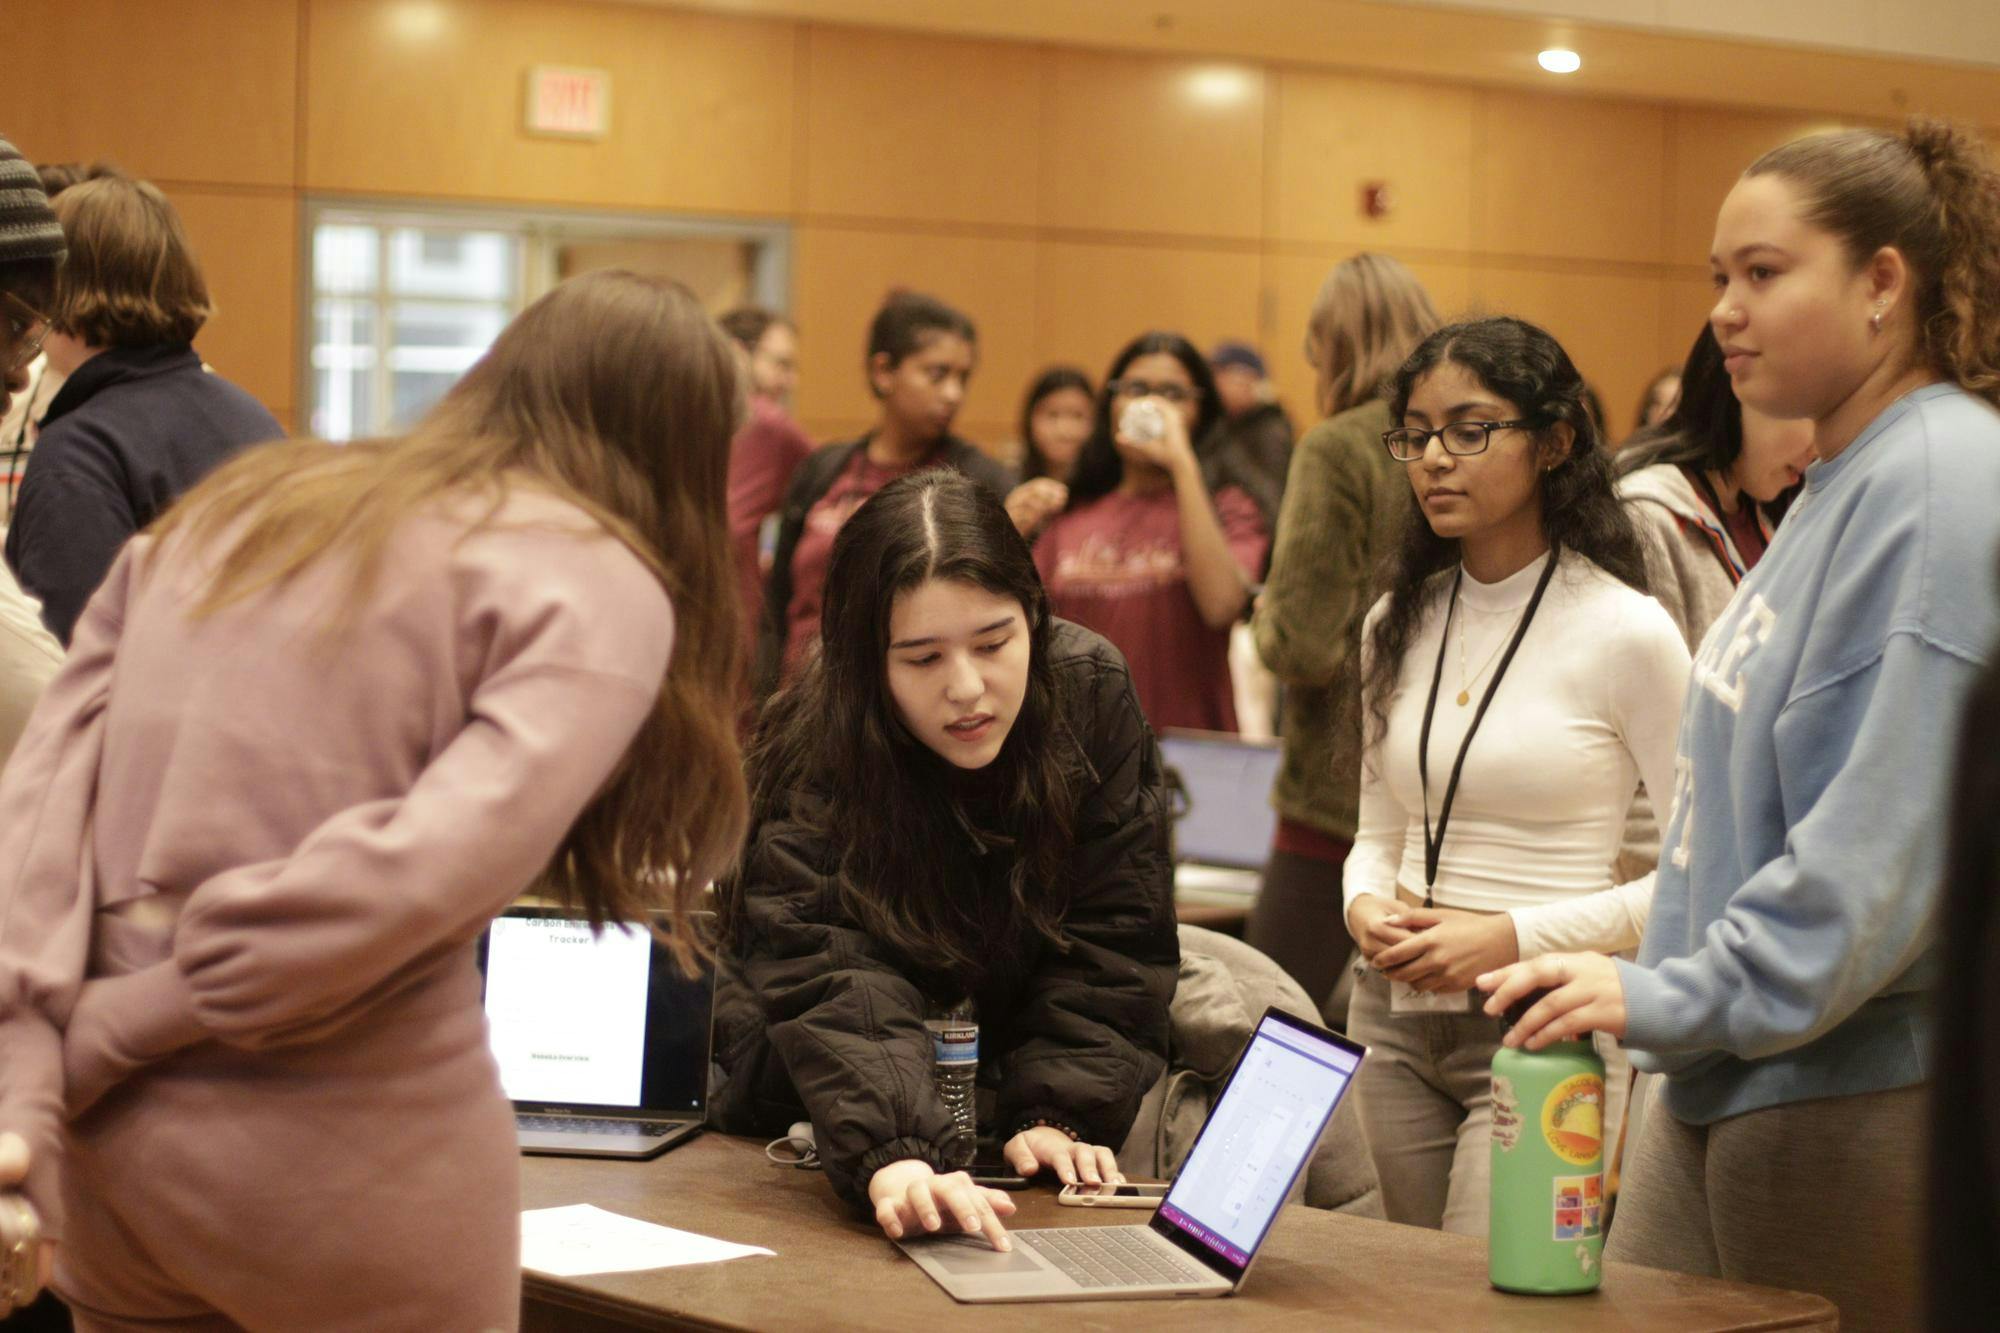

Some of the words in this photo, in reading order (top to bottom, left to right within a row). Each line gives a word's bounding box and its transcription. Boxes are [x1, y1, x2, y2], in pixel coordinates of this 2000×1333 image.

[526, 918, 562, 928] Carbon
[563, 918, 615, 929] Emisns
[549, 934, 590, 944] Tracker
[1569, 1146, 1600, 1160] LANGU
